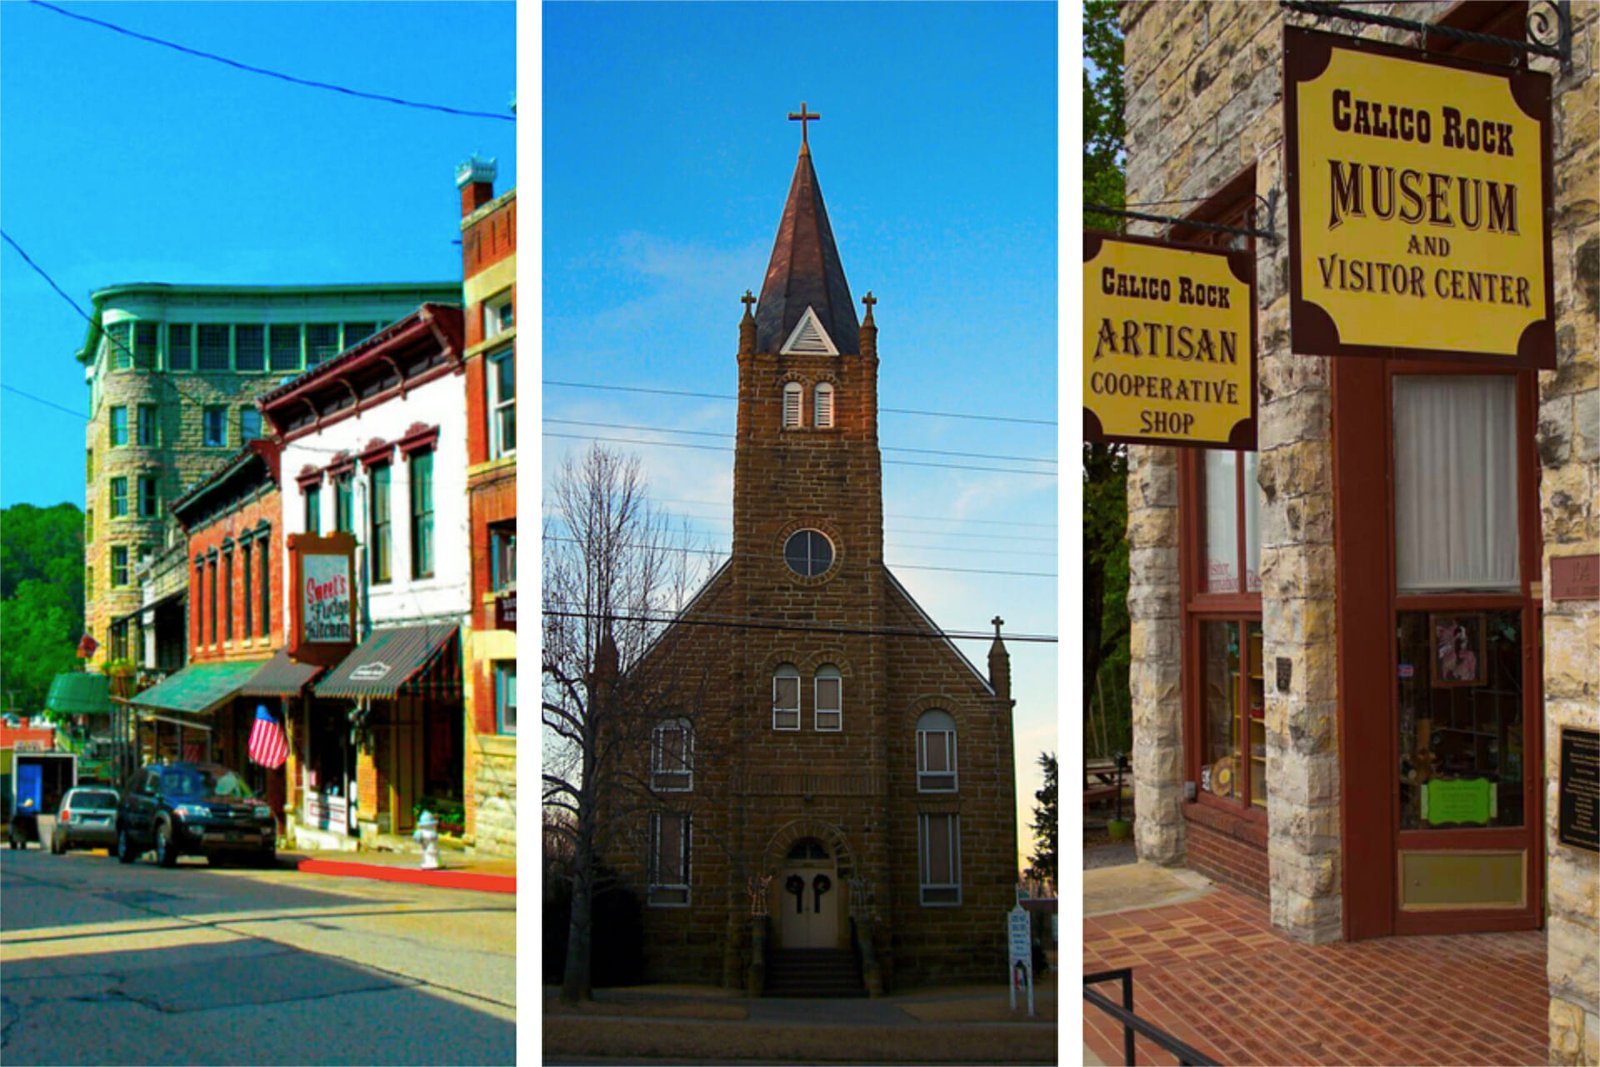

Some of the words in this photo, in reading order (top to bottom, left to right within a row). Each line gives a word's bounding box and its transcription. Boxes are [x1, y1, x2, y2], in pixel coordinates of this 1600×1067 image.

[1332, 88, 1431, 144] CALICO
[1443, 105, 1514, 157] ROCK
[1328, 159, 1520, 236] MUSEUM
[1407, 234, 1451, 258] AND
[1102, 266, 1171, 302] CALICO
[1178, 275, 1230, 309] ROCK
[1317, 253, 1426, 299] VISITOR
[1434, 267, 1532, 309] CENTER
[1093, 317, 1238, 366] ARTISAN
[1090, 371, 1239, 405] COOPERATIVE
[1139, 409, 1195, 435] SHOP
